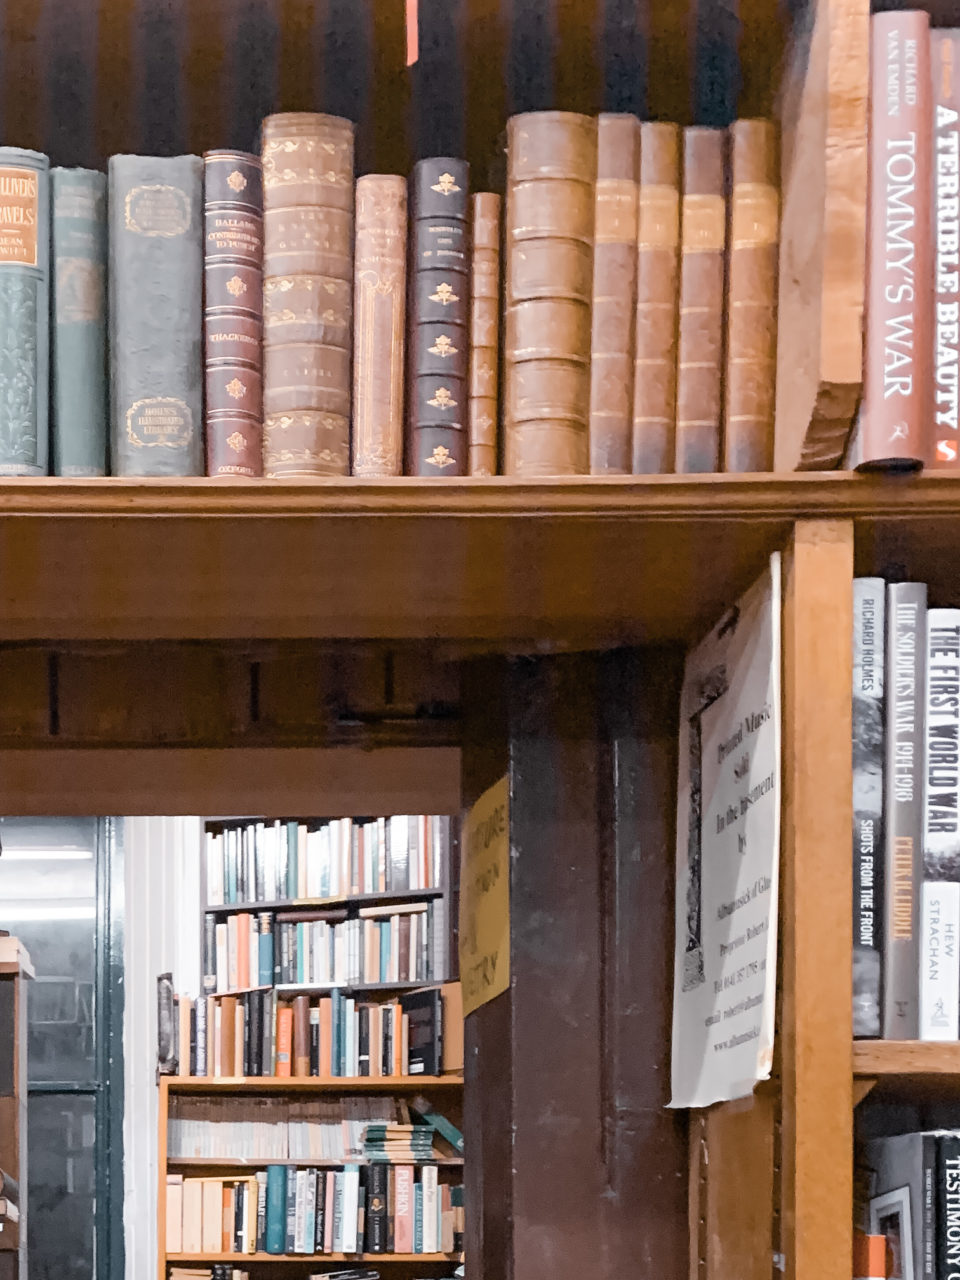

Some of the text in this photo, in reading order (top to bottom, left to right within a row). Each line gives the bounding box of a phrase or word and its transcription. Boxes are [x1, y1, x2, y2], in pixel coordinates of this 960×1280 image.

[887, 29, 899, 60] VAN
[904, 39, 917, 105] RICHARD
[935, 104, 959, 129] A
[935, 130, 959, 294] TERRIBLE
[883, 131, 917, 400] TOMMY'S WAR
[934, 301, 959, 429] BEAUTY
[861, 599, 874, 691] RICHARD HOLMES
[897, 603, 918, 627] THE
[744, 703, 772, 735] Music
[895, 700, 915, 732] WAR
[927, 625, 960, 833] THE FIRST WORLD WAR
[895, 741, 914, 803] 1914-1918
[716, 812, 725, 834] In
[726, 803, 738, 826] the
[860, 819, 874, 947] SHOTS FROM THE FRONT
[929, 900, 940, 981] STRACHAN
[944, 923, 954, 958] HEW
[398, 1169, 409, 1216] PUSHKIN
[945, 1155, 960, 1270] TESTIMONY
